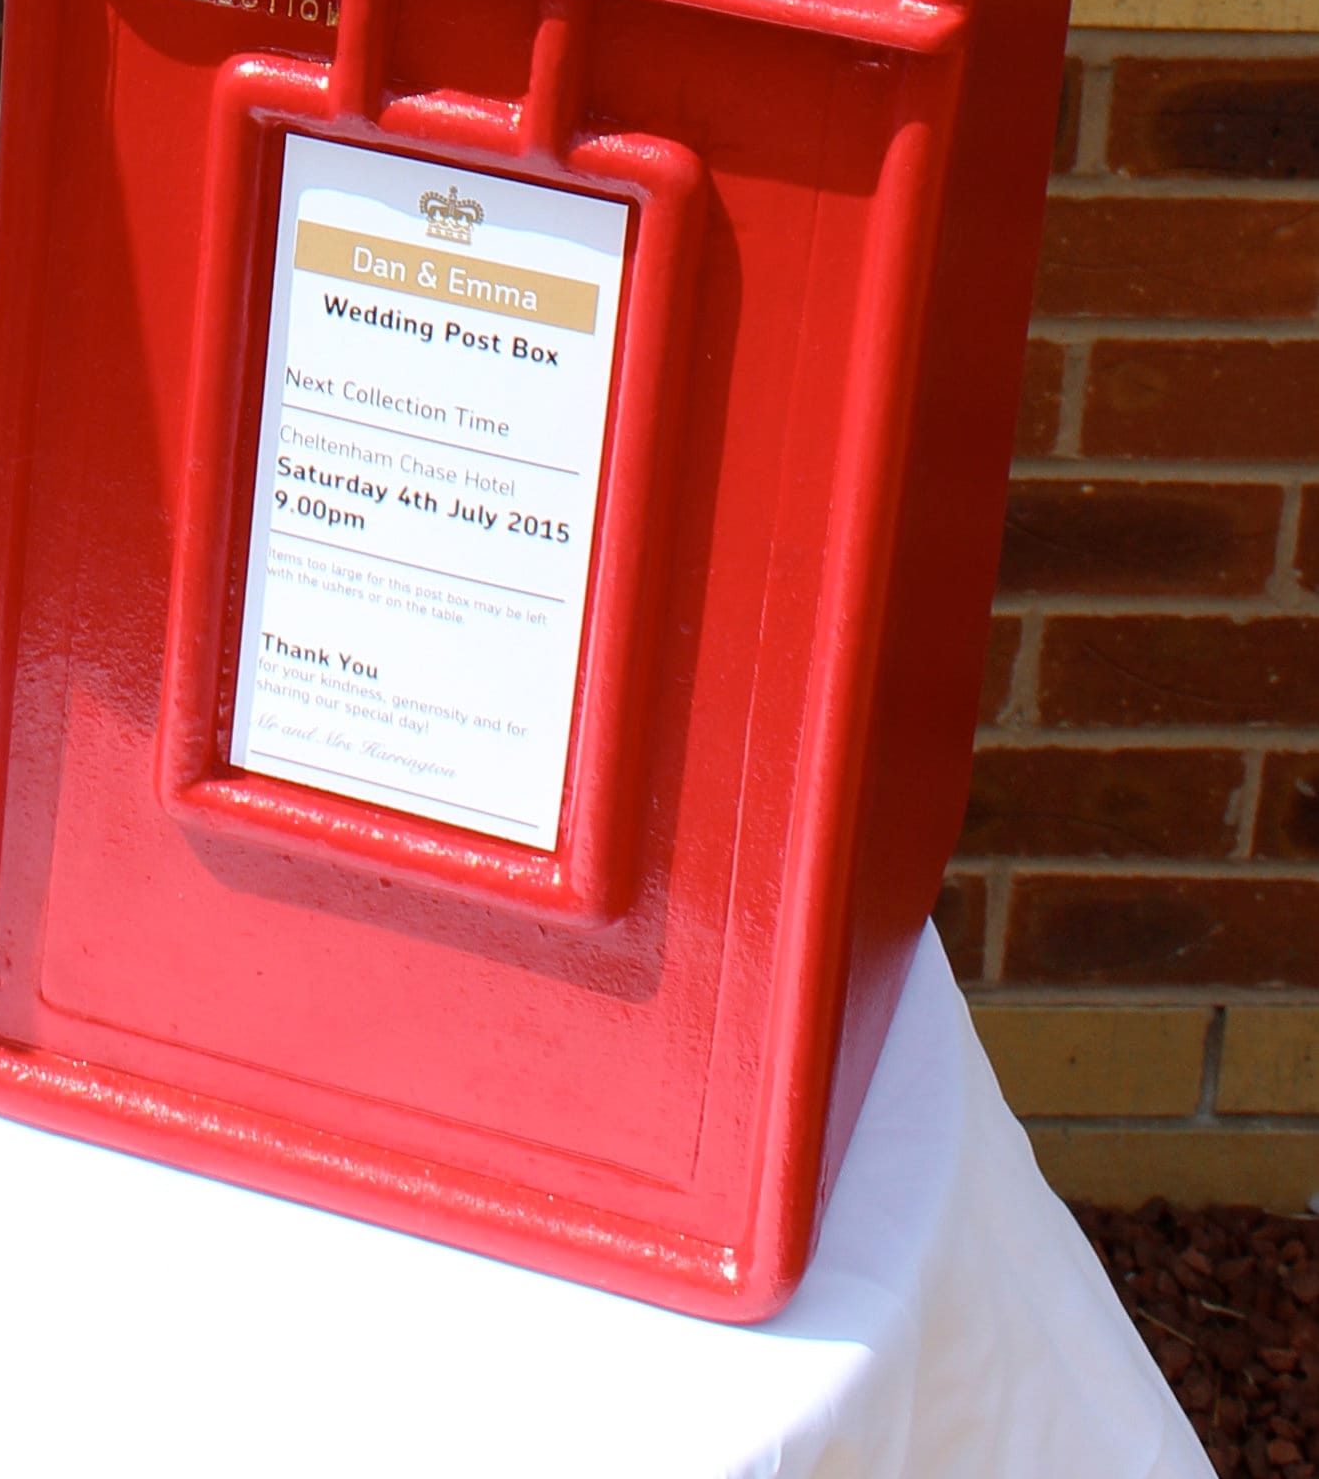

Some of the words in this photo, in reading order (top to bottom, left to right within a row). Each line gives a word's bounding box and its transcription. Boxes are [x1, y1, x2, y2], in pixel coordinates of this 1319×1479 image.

[352, 245, 405, 281] Dan
[417, 262, 438, 289] &
[448, 268, 538, 311] Emma
[324, 294, 434, 342] Wedding
[445, 322, 501, 353] Post
[512, 337, 559, 366] Box
[285, 366, 335, 396] Next
[343, 381, 446, 422] Collection
[456, 407, 510, 437] Time
[279, 424, 393, 468] Cheltenham
[400, 455, 457, 483] Chase
[465, 470, 515, 496] Hotel
[274, 490, 365, 531] 9.00pm
[277, 457, 388, 503] Saturday
[398, 486, 438, 514] 4th
[447, 498, 498, 531] July
[507, 512, 570, 543] 2015
[266, 564, 293, 580] with
[297, 571, 318, 587] the
[322, 578, 364, 601] ushers
[368, 592, 381, 603] or
[386, 596, 402, 609] on
[407, 597, 428, 615] the
[432, 604, 464, 624] table.
[268, 547, 302, 567] Items
[307, 557, 327, 572] too
[331, 564, 363, 582] large
[367, 571, 384, 586] for
[388, 577, 411, 593] this
[415, 585, 443, 603] post
[447, 592, 470, 608] box
[474, 601, 502, 617] may
[506, 605, 522, 619] be
[525, 611, 547, 626] left
[261, 632, 329, 666] Thank
[339, 653, 379, 680] You
[256, 679, 310, 704] sharing
[315, 695, 339, 710] our
[345, 702, 393, 725] special
[399, 716, 430, 735] day!
[258, 657, 278, 672] for
[283, 666, 316, 685] your
[392, 693, 468, 723] generosity
[474, 712, 501, 730] and
[506, 720, 527, 737] for
[281, 725, 316, 741] and
